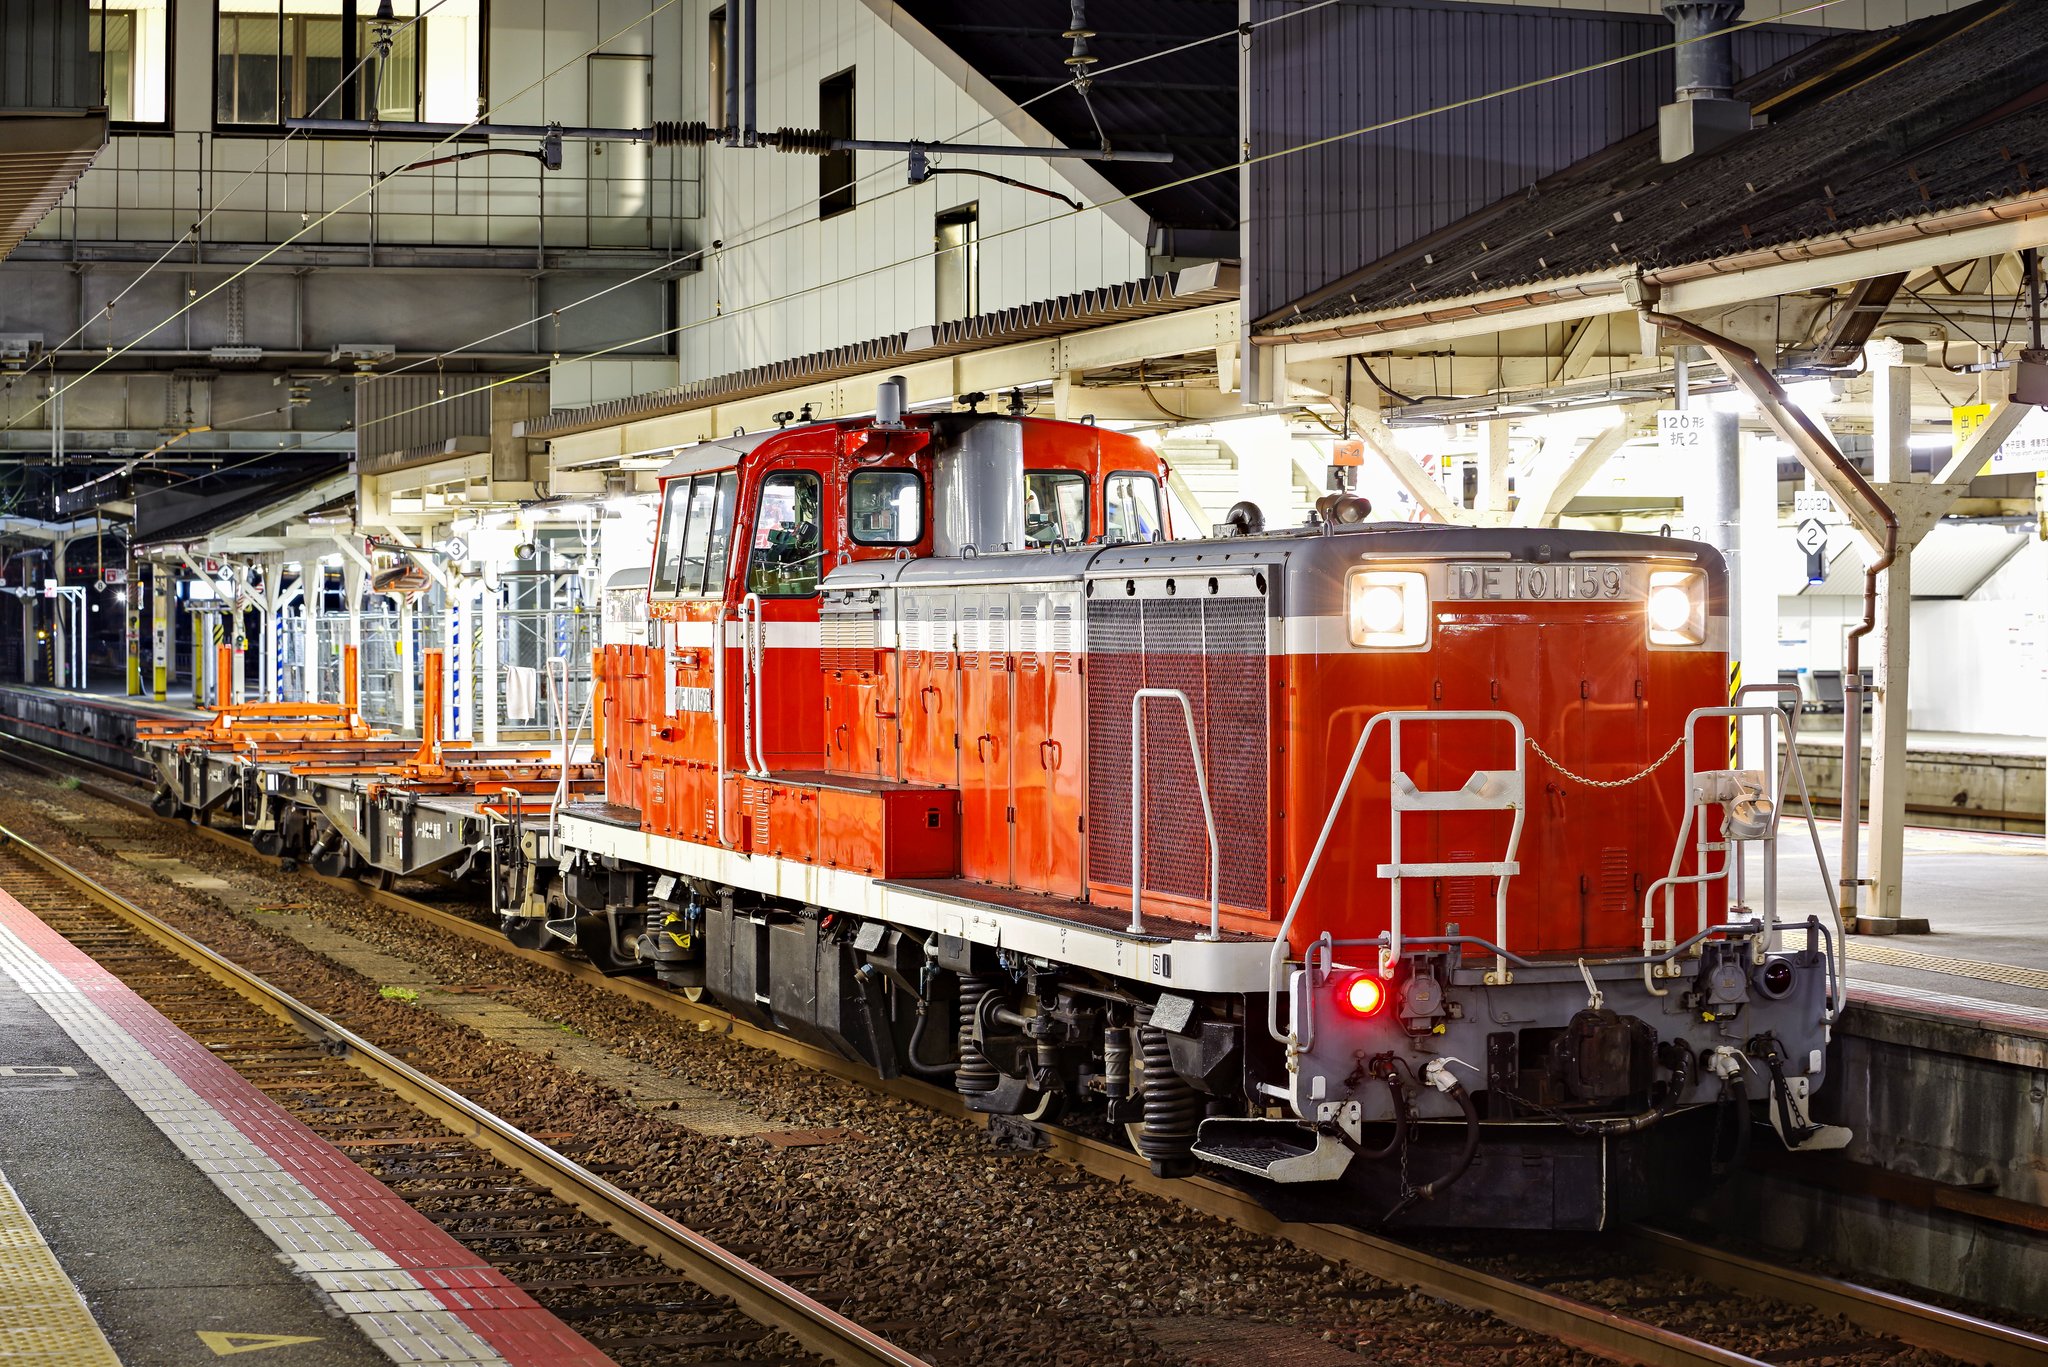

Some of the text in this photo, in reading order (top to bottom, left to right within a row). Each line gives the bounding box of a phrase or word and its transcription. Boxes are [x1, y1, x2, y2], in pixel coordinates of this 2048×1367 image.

[1807, 527, 1818, 546] 2
[452, 542, 461, 556] 3
[222, 568, 229, 577] 4
[1459, 566, 1502, 599] DE
